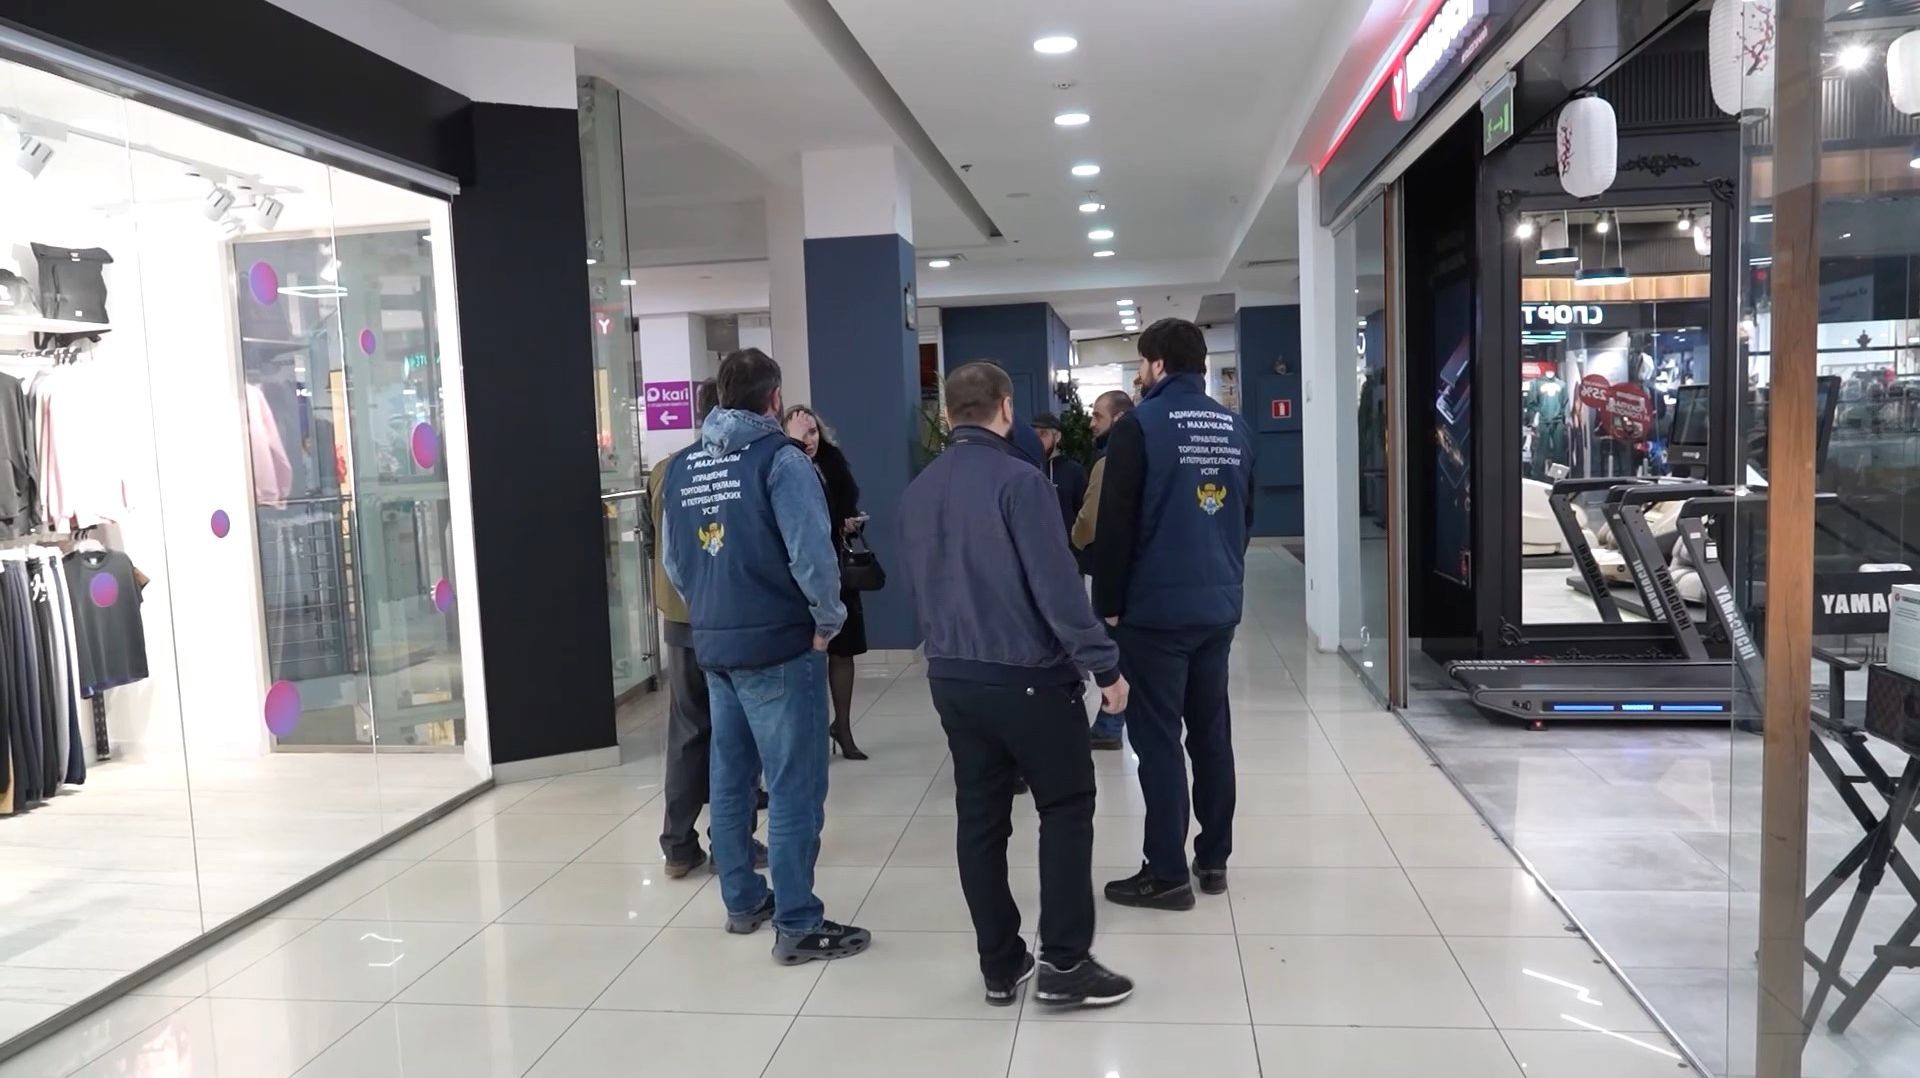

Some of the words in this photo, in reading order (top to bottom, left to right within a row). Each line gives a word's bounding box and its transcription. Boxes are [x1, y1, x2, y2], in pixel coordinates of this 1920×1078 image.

[662, 387, 689, 401] kari
[1168, 411, 1233, 423] АДМИНИСТРАЦИЯ
[1186, 421, 1234, 431] МАХАЧКАЛЫ
[1190, 435, 1229, 444] УПРАВЛЕНИЕ
[1210, 446, 1241, 455] РЕКЛАМЫ
[692, 469, 728, 483] УПРАВЛЕНИЕ
[1654, 565, 1692, 631] YAMAGUCHI
[1714, 585, 1757, 660] YAMAGUCHI
